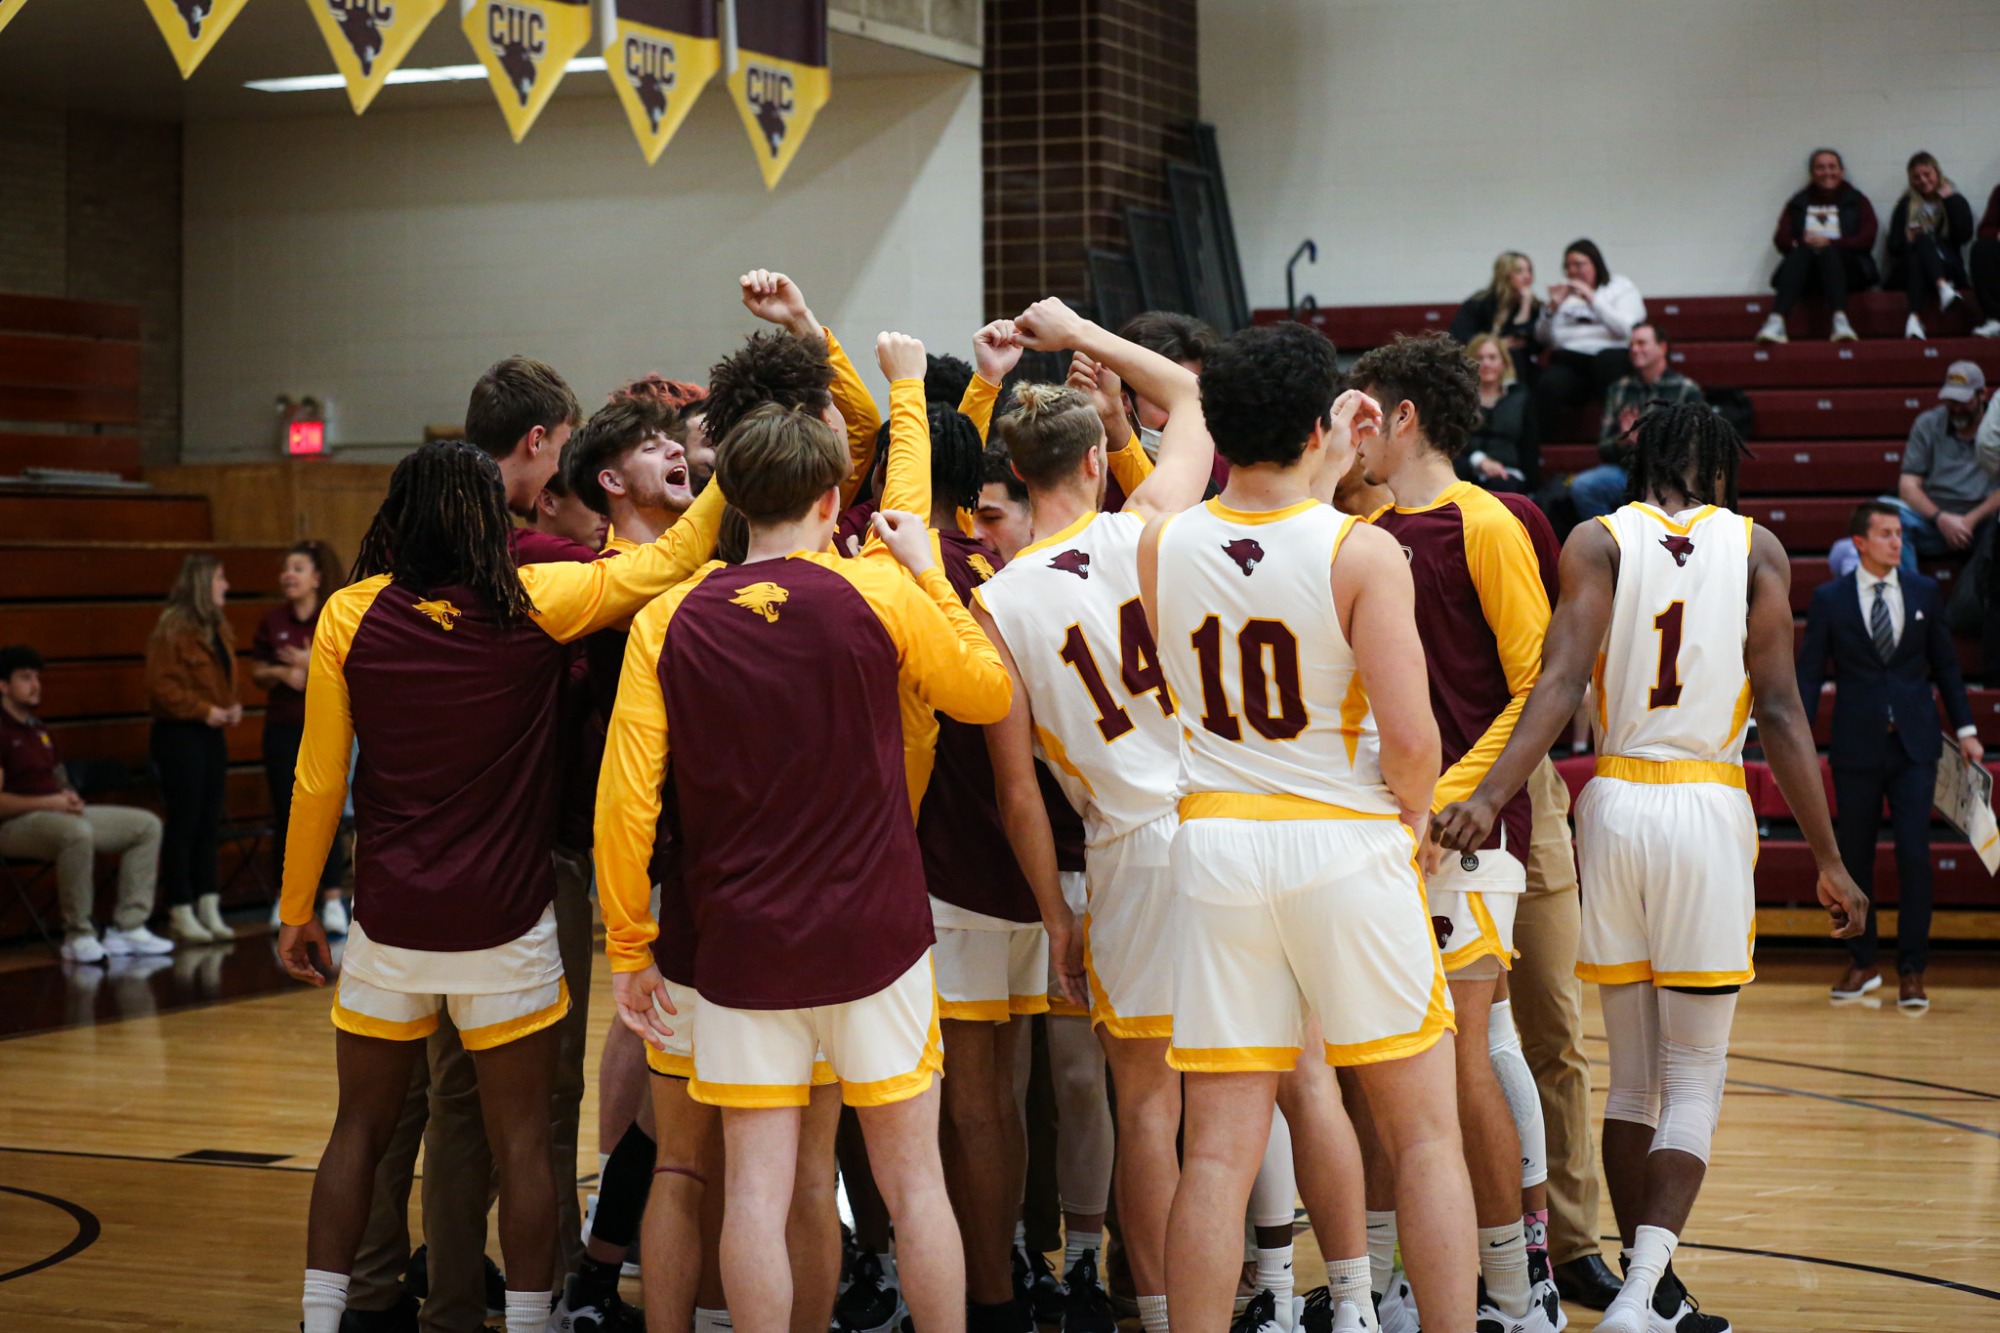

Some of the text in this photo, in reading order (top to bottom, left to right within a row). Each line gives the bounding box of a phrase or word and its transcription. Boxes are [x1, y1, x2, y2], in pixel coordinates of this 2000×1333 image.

[488, 3, 545, 54] CUC
[625, 37, 676, 85] CUC
[746, 66, 794, 111] CUC
[1058, 594, 1175, 744] 14
[1190, 613, 1310, 743] 10
[1648, 600, 1686, 711] 1
